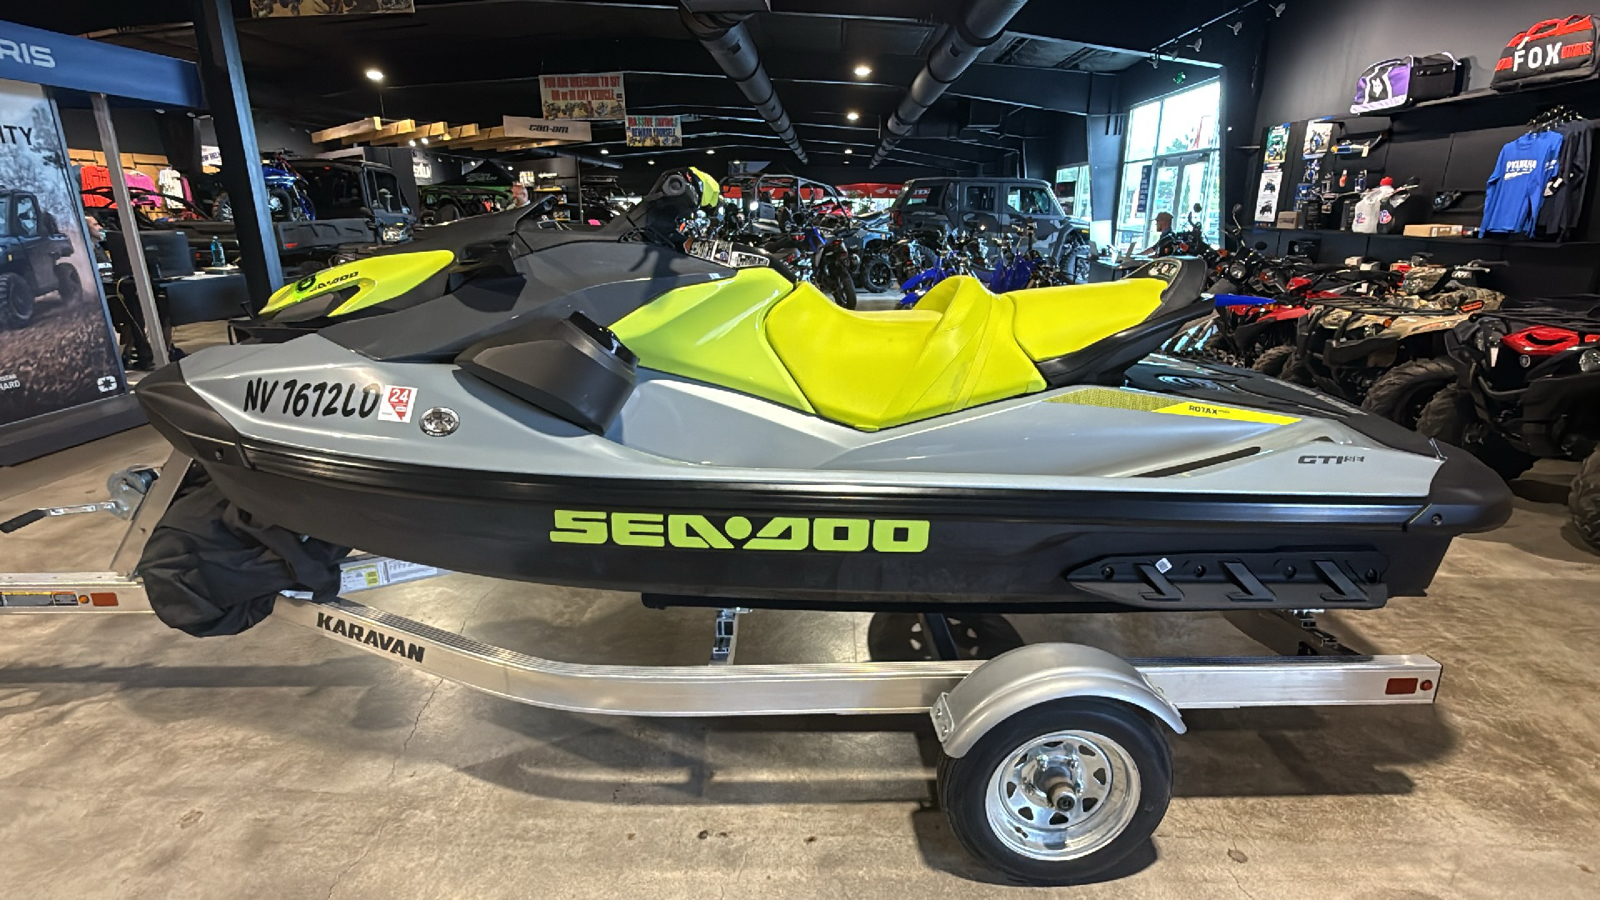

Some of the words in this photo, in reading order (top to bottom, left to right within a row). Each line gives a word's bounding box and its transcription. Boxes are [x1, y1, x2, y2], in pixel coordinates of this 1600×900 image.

[0, 39, 55, 68] RIS
[1513, 42, 1562, 72] FOX
[243, 377, 279, 414] NV
[389, 389, 409, 403] 24
[1188, 405, 1217, 415] ROTAX
[1297, 455, 1344, 464] GTI
[317, 612, 425, 664] KARAVAN
